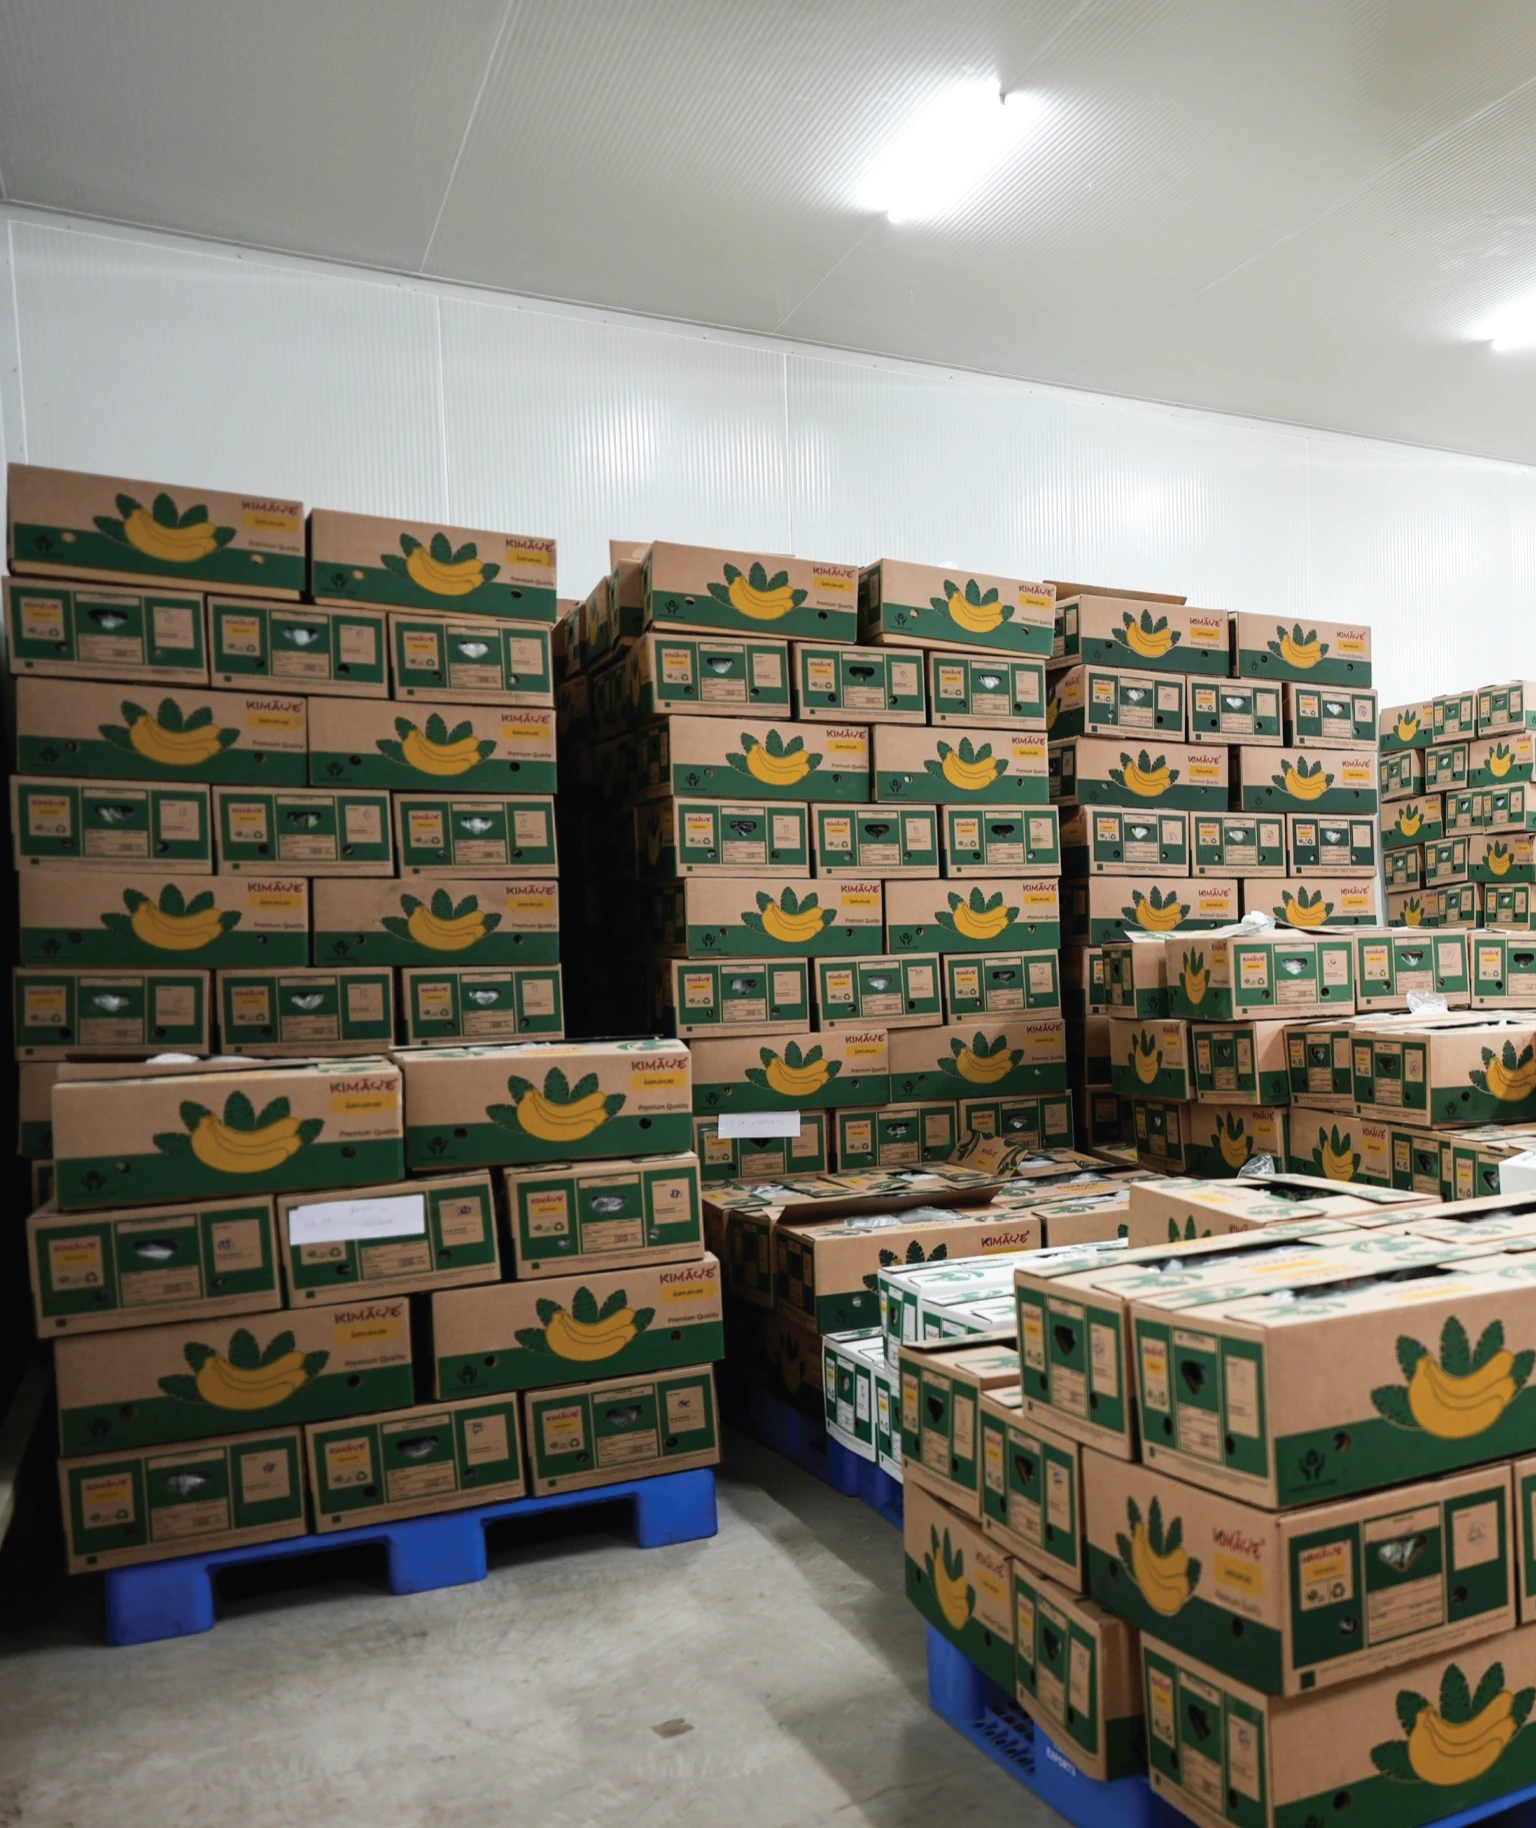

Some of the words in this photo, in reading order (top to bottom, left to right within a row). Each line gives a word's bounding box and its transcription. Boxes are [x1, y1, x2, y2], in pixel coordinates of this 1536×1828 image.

[281, 741, 303, 749] Quality
[667, 1102, 688, 1110] Quality
[339, 1129, 371, 1137] Premium
[373, 1127, 398, 1136] Quality
[668, 1314, 694, 1323] Premium
[696, 1311, 718, 1321] Quality
[344, 1357, 375, 1367] Premium
[378, 1353, 405, 1364] Quality
